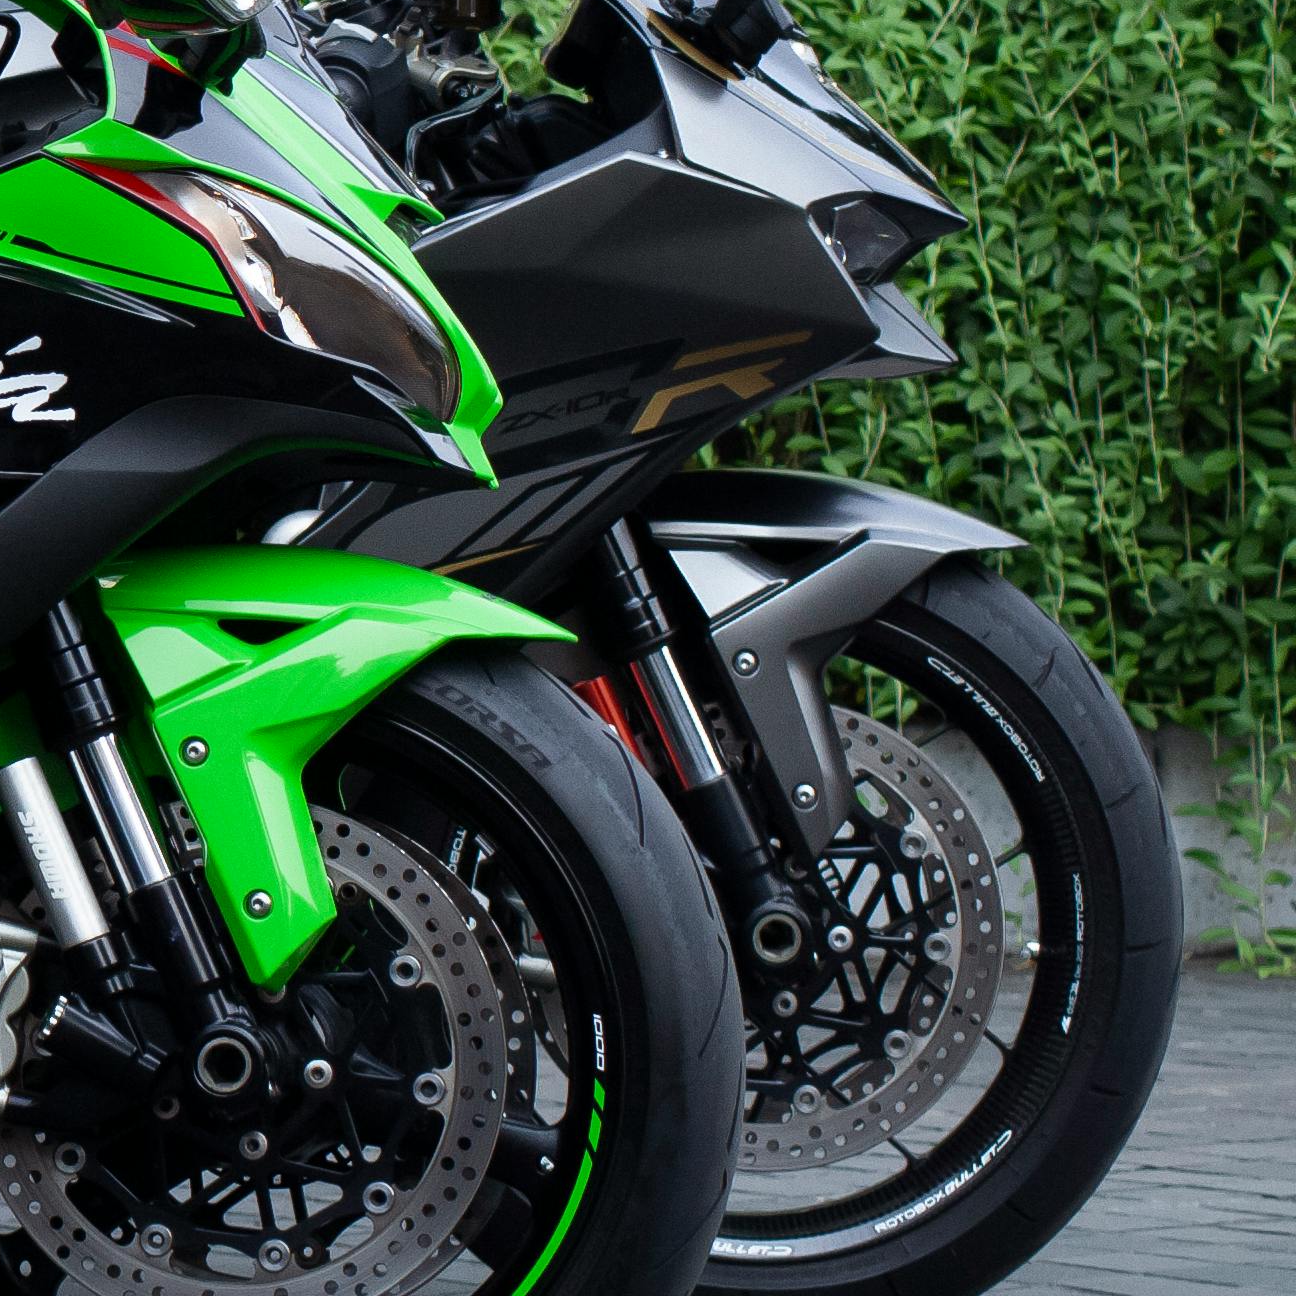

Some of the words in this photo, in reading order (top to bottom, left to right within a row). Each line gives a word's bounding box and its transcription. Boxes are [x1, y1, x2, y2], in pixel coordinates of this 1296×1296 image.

[995, 715, 1045, 783] ROTOBOX
[17, 811, 70, 899] SHOWA
[593, 1013, 605, 1073] 1000
[874, 1188, 946, 1233] ROTOBOX
[711, 1242, 792, 1257] ULLET
